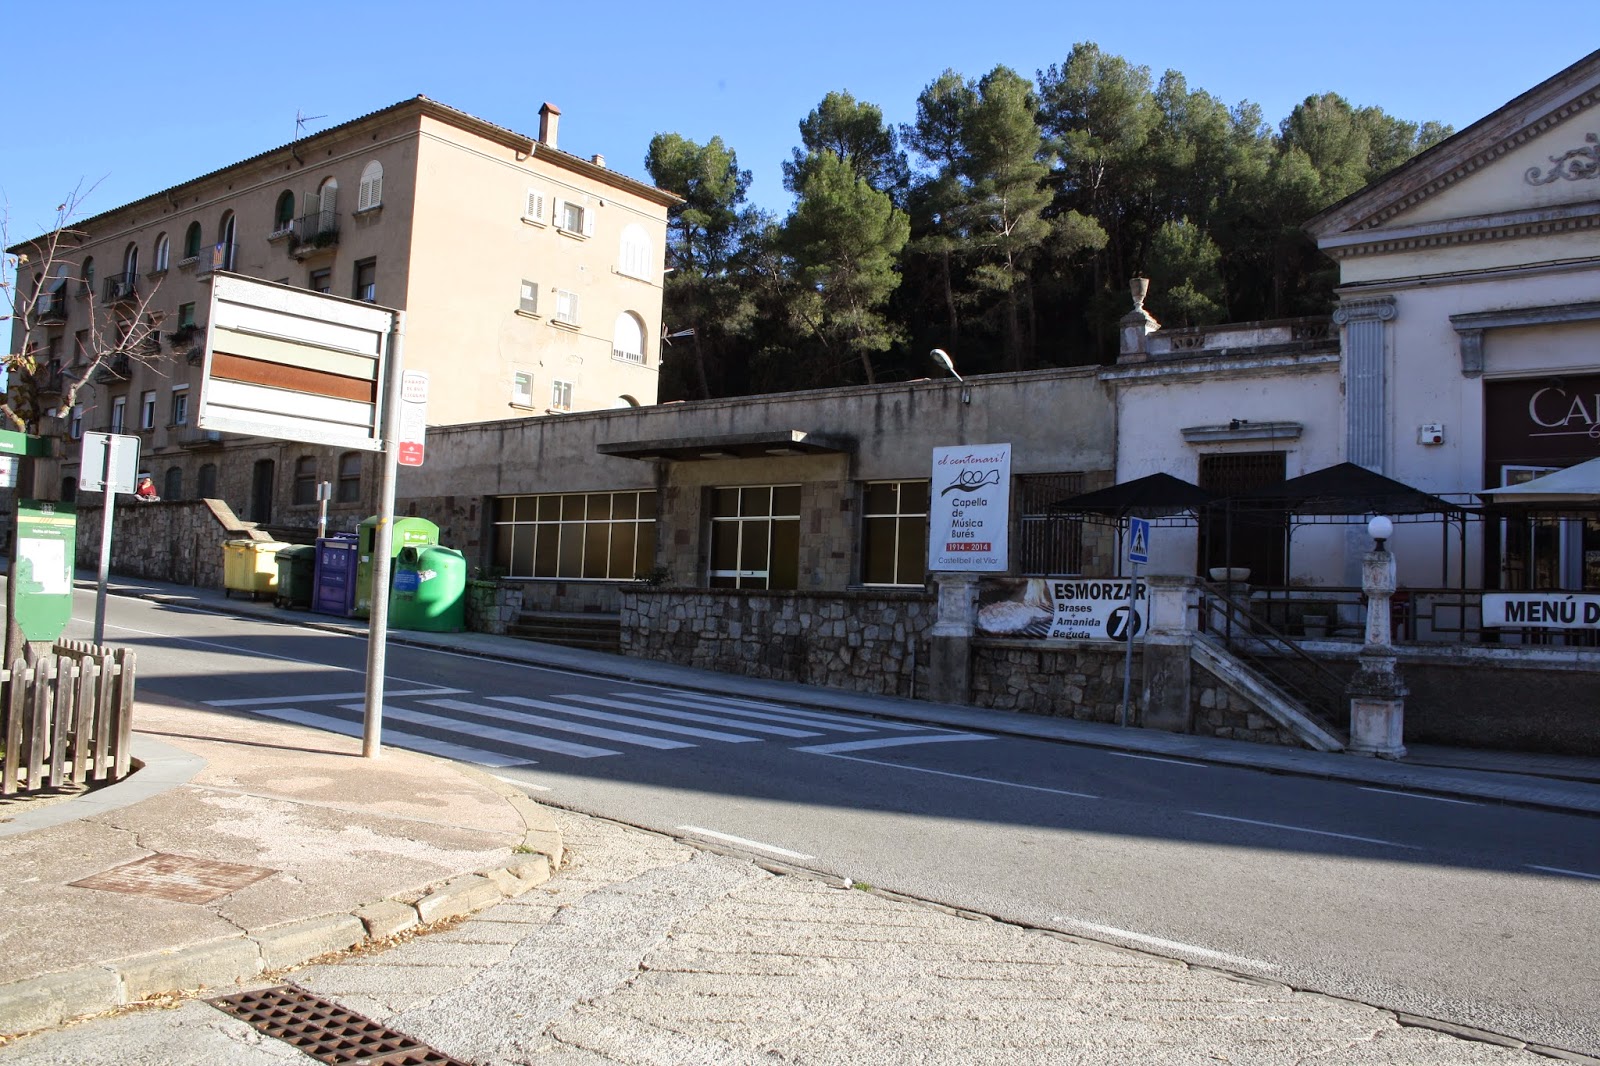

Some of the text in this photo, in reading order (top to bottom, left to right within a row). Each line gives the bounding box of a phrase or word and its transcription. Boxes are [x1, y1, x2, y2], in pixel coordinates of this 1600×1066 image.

[938, 454, 949, 465] el
[952, 498, 988, 508] Capella
[952, 509, 963, 518] de
[952, 518, 983, 528] Música
[951, 528, 975, 538] Burés
[1055, 583, 1146, 600] ESMORZAR
[1058, 603, 1092, 612] Brases
[1505, 595, 1576, 624] MENÚ
[1056, 617, 1100, 627] Amanida
[1053, 629, 1090, 639] Beguda
